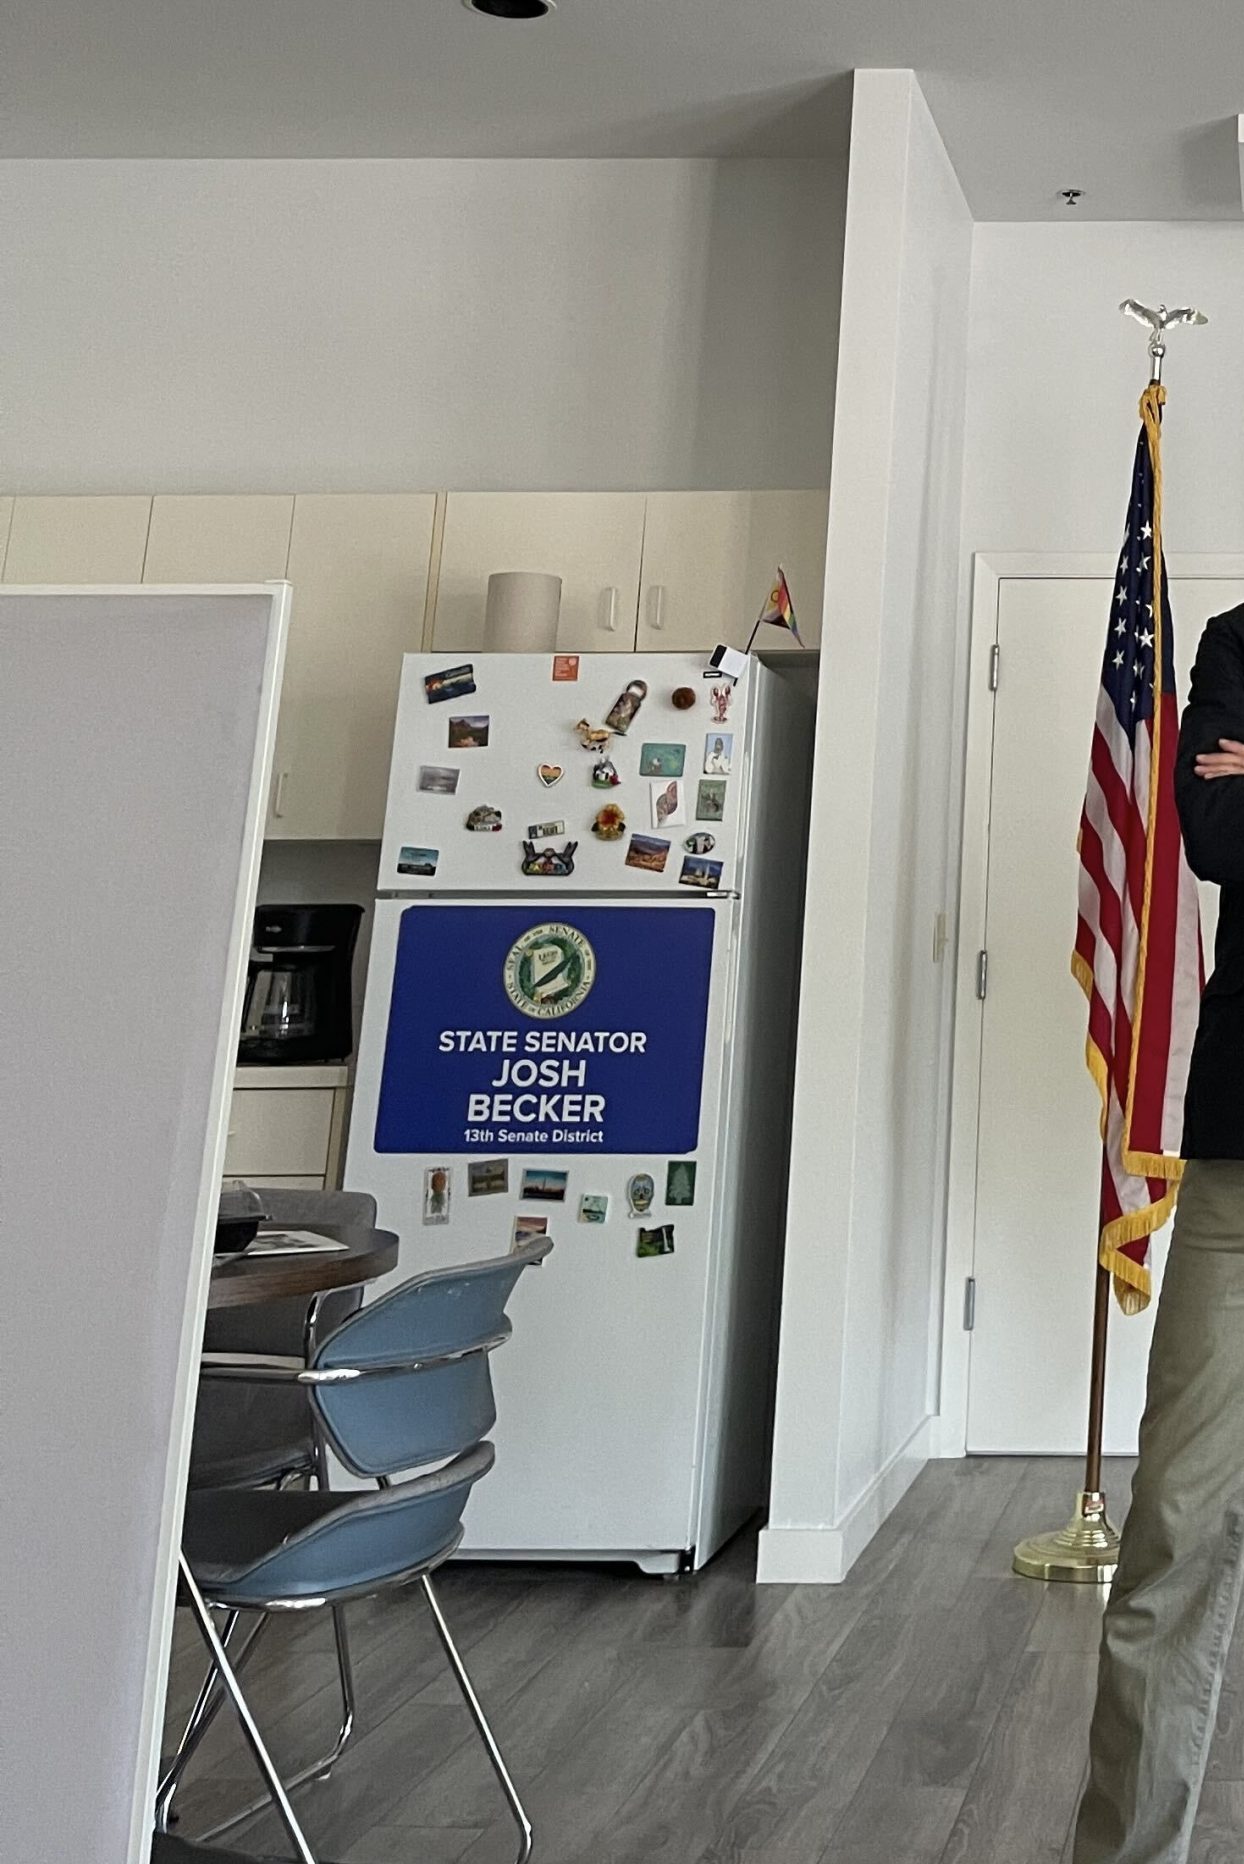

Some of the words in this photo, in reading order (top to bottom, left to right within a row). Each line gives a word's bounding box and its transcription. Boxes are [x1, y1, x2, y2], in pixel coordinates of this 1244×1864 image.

[549, 925, 585, 946] SENATE
[439, 1031, 517, 1051] STATE
[525, 1032, 646, 1052] SENATOR
[492, 1060, 586, 1087] JOSH
[468, 1094, 605, 1122] BECKER
[464, 1129, 493, 1142] 13th
[498, 1129, 548, 1142] Senate
[553, 1130, 603, 1142] District
